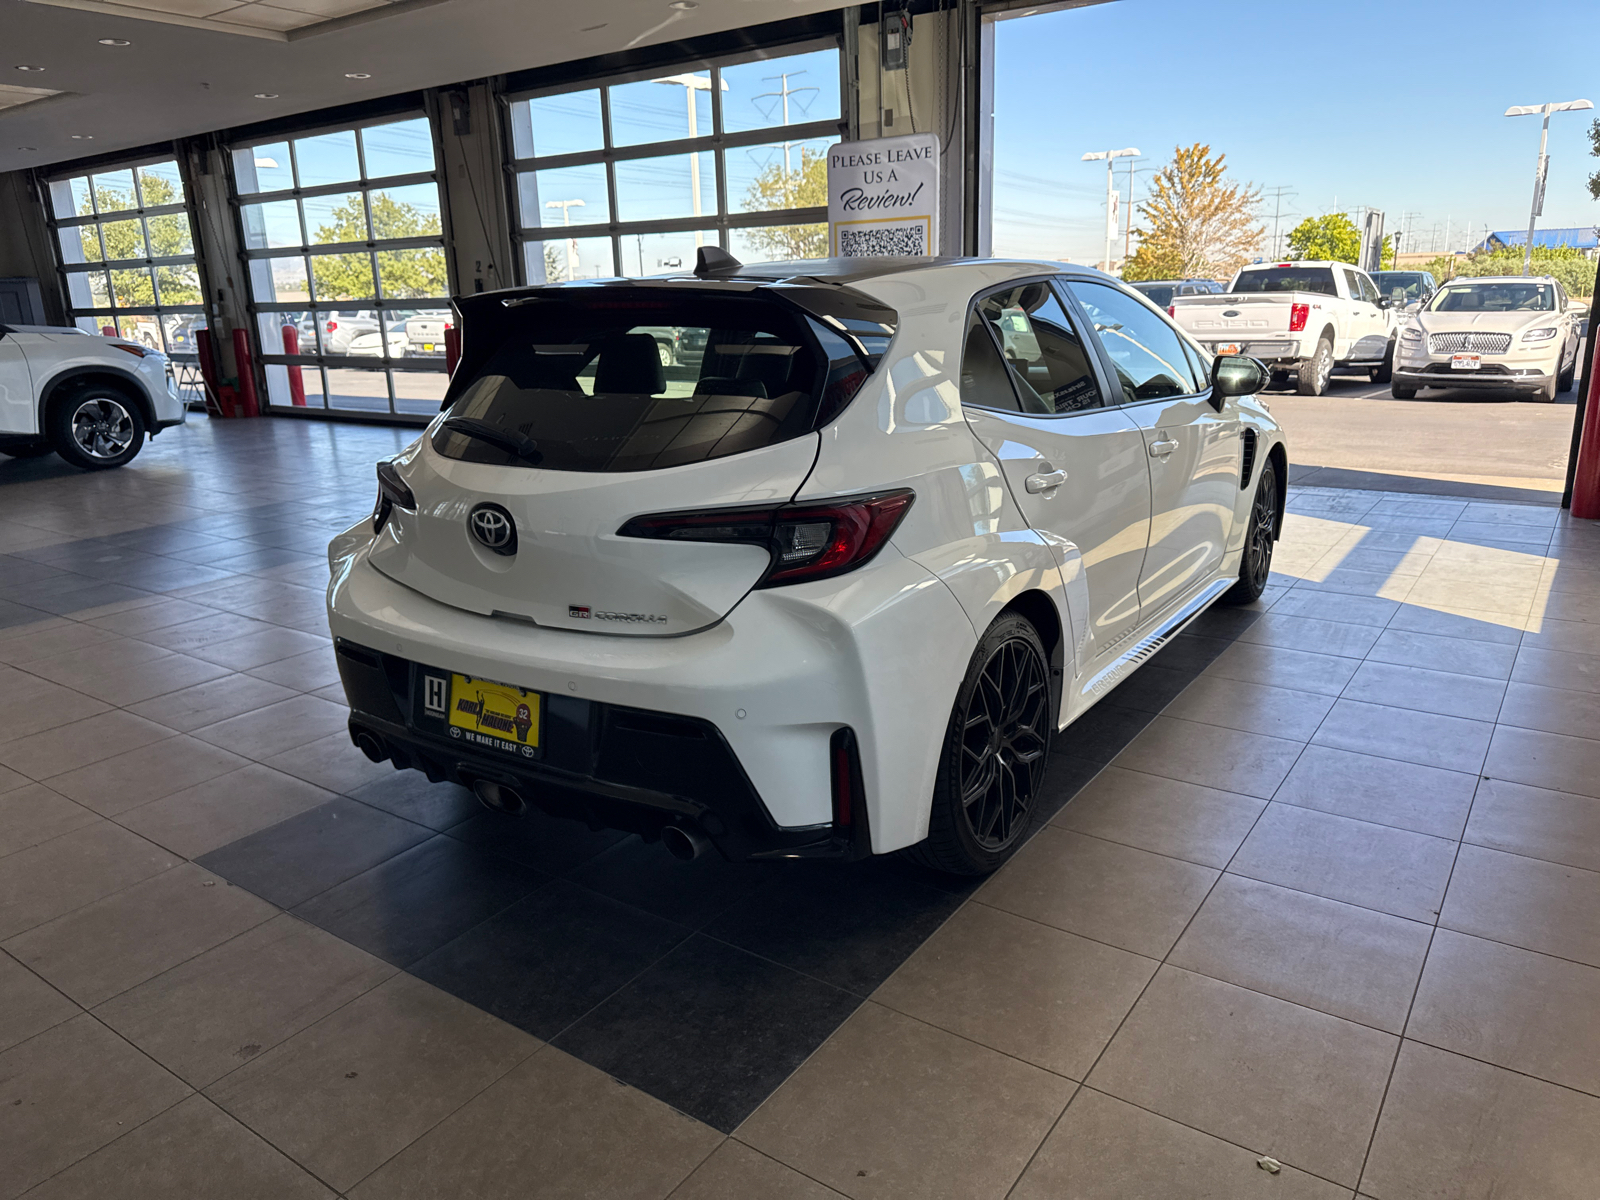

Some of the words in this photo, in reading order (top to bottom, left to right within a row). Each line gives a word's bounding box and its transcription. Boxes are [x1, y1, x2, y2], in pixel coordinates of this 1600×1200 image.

[832, 152, 881, 168] PLEASE
[887, 146, 932, 163] LEAVE
[887, 168, 898, 182] A
[840, 182, 924, 211] Review!
[1193, 320, 1268, 328] F-150
[569, 610, 589, 618] GR
[595, 611, 667, 624] COROLLA
[518, 708, 529, 720] 32
[465, 731, 476, 741] WE
[476, 733, 493, 746] MAKE
[494, 739, 501, 748] IT
[501, 741, 517, 752] EASY
